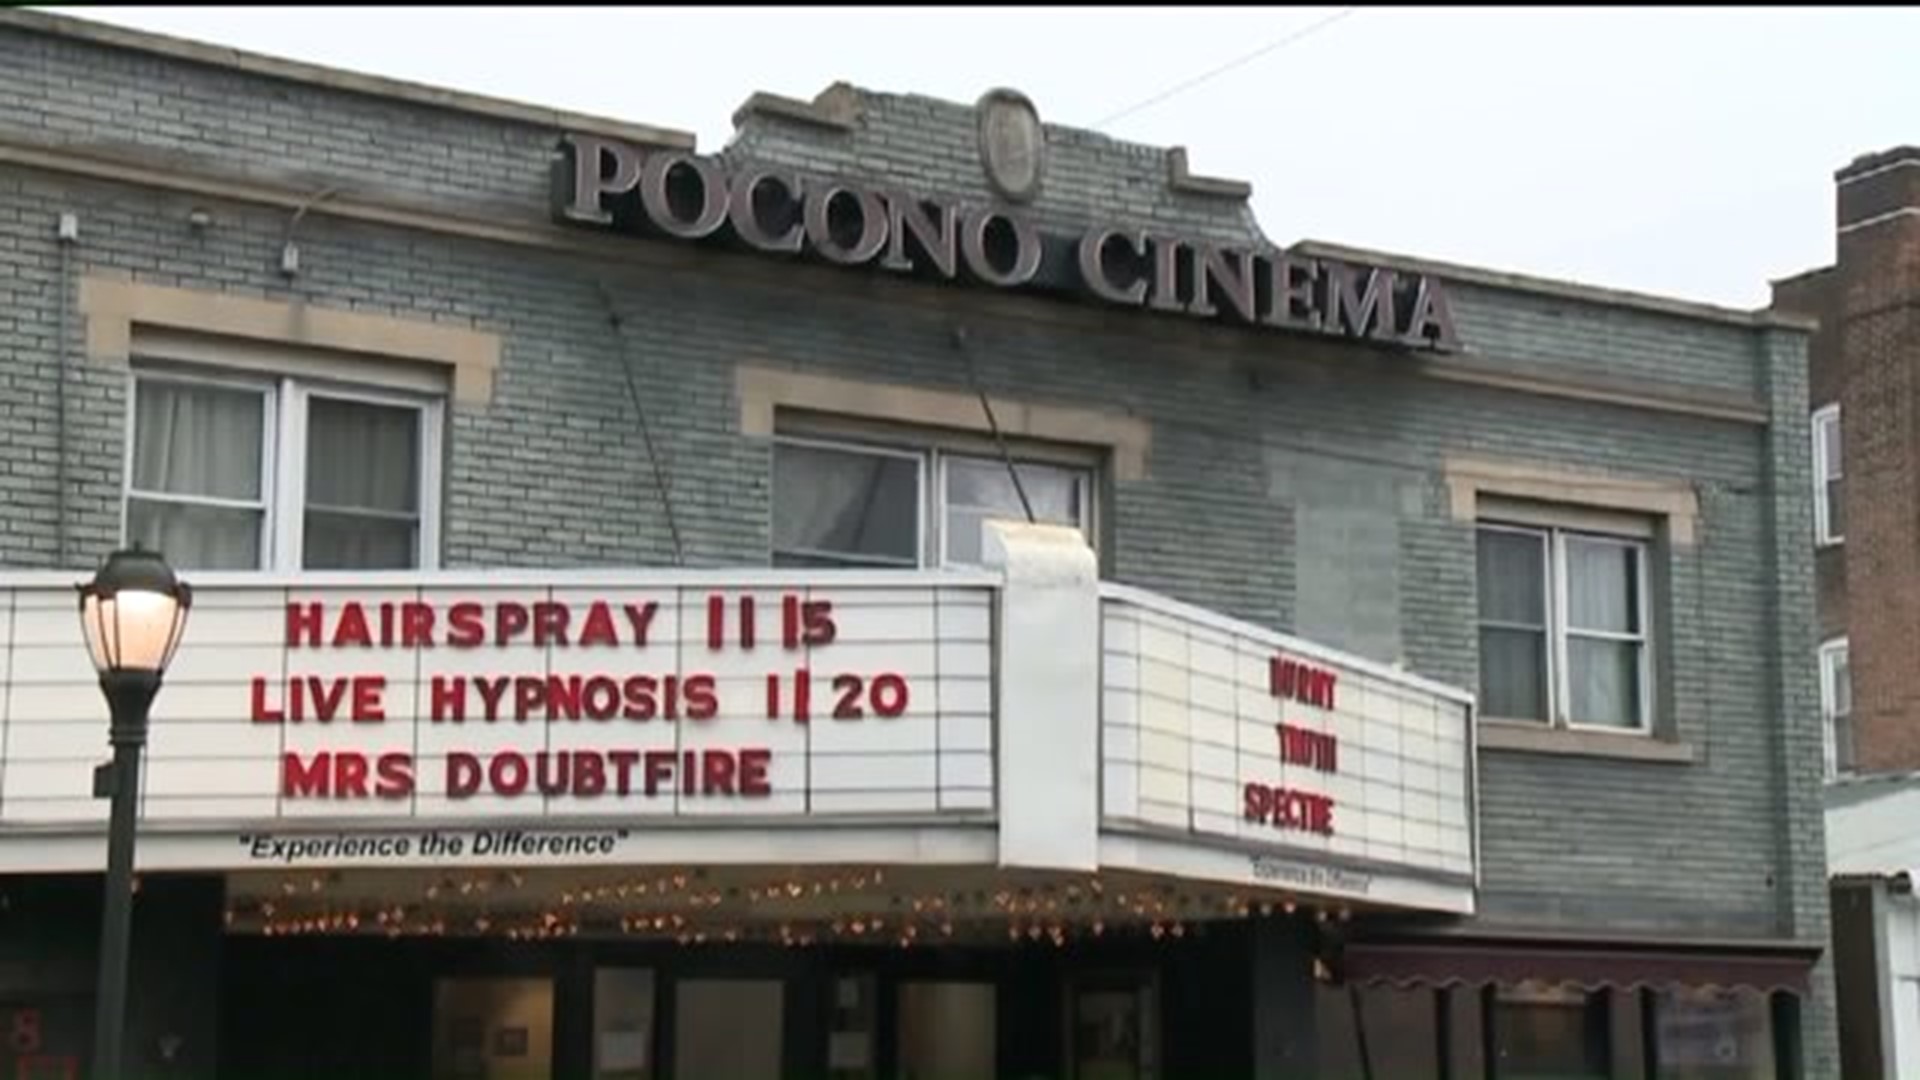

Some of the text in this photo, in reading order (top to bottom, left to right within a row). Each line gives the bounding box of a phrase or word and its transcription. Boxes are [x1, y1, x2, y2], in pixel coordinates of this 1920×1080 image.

[566, 136, 1462, 353] POCONO CINEMA
[286, 599, 656, 647] HAIRSPRAY
[250, 675, 385, 723] LIVE
[431, 673, 719, 722] HYPNOSIS
[833, 673, 910, 719] 20
[280, 749, 771, 798] MRS DOUBTFIRE
[238, 829, 630, 861] "Experience the Difference"
